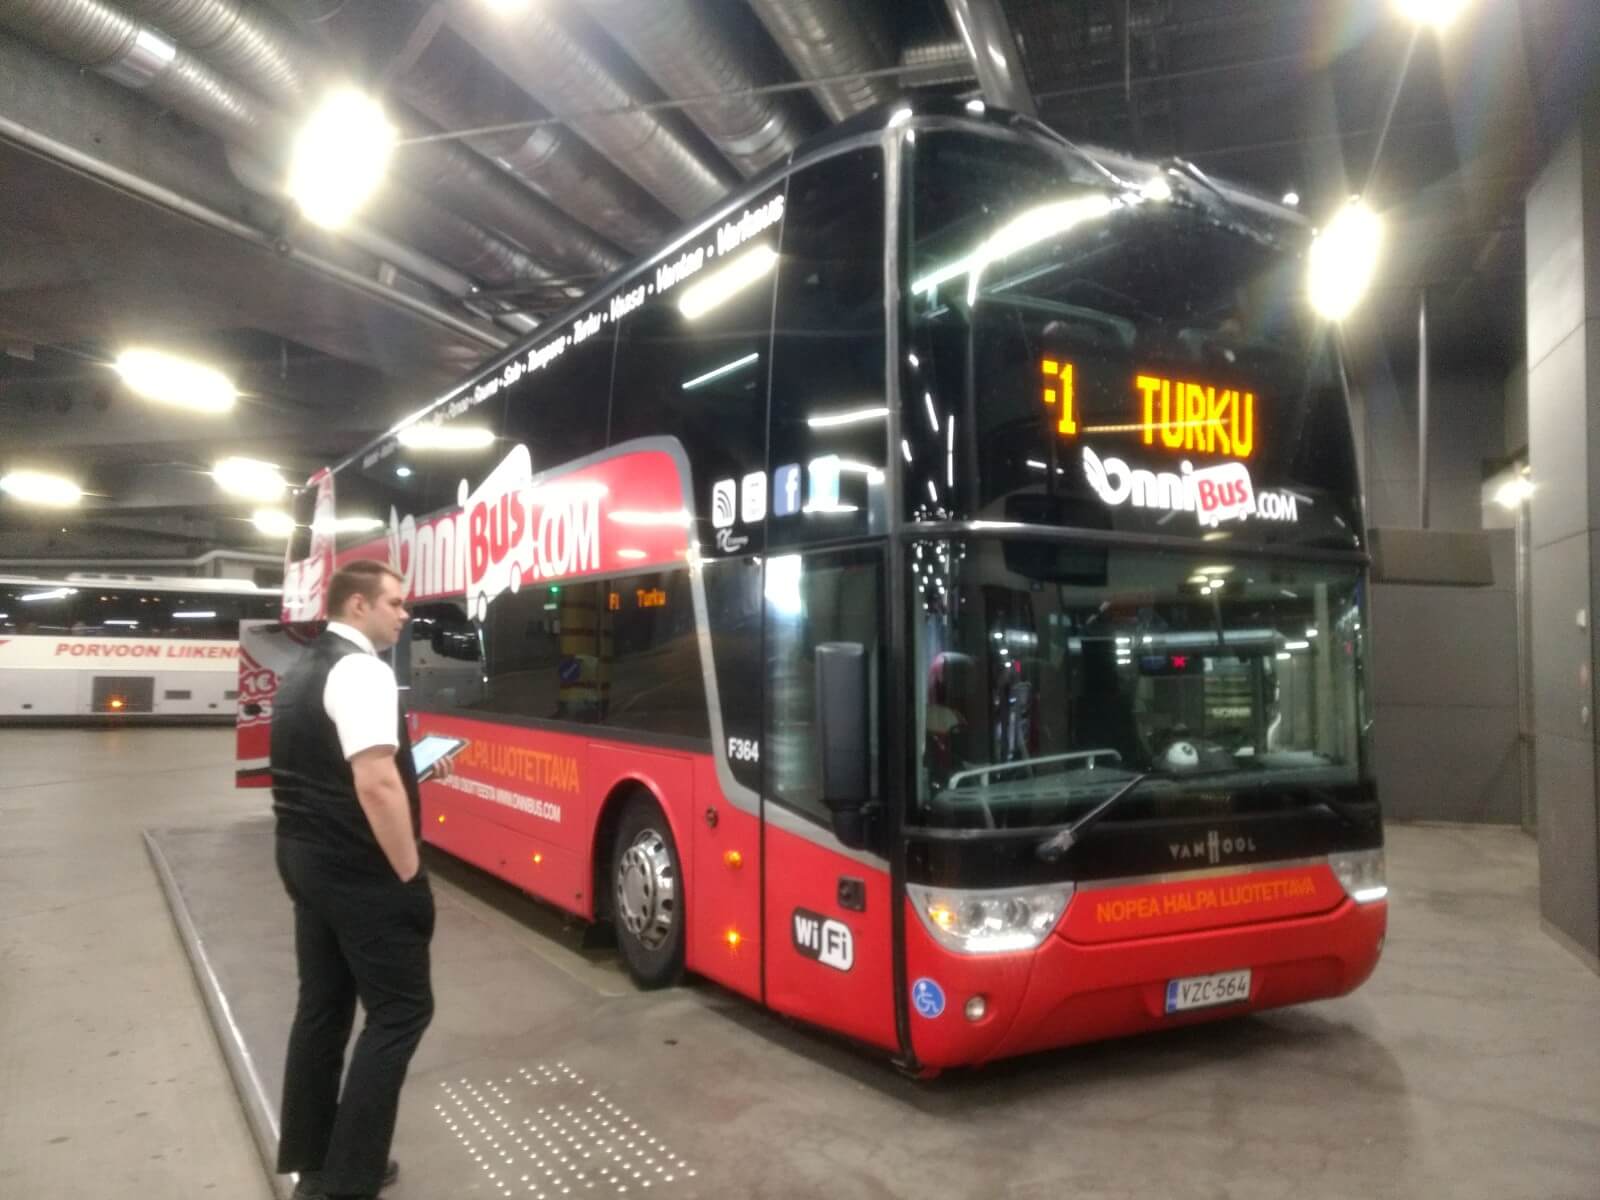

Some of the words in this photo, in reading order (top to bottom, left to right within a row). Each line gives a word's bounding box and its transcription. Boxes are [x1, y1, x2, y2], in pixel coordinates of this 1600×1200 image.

[574, 312, 601, 344] Turku
[610, 285, 645, 322] Vaasa
[656, 247, 704, 294] Vantaa
[717, 195, 784, 256] Varkaus
[1136, 375, 1253, 457] TURKU
[55, 643, 160, 657] PORVOON
[491, 742, 581, 794] LUOTETTAVA
[728, 737, 760, 762] F364
[1096, 897, 1161, 924] NOPEA
[1163, 888, 1218, 914] HALPA
[1219, 876, 1316, 907] LUOTETTAVA
[1181, 974, 1248, 1003] VZC-564
